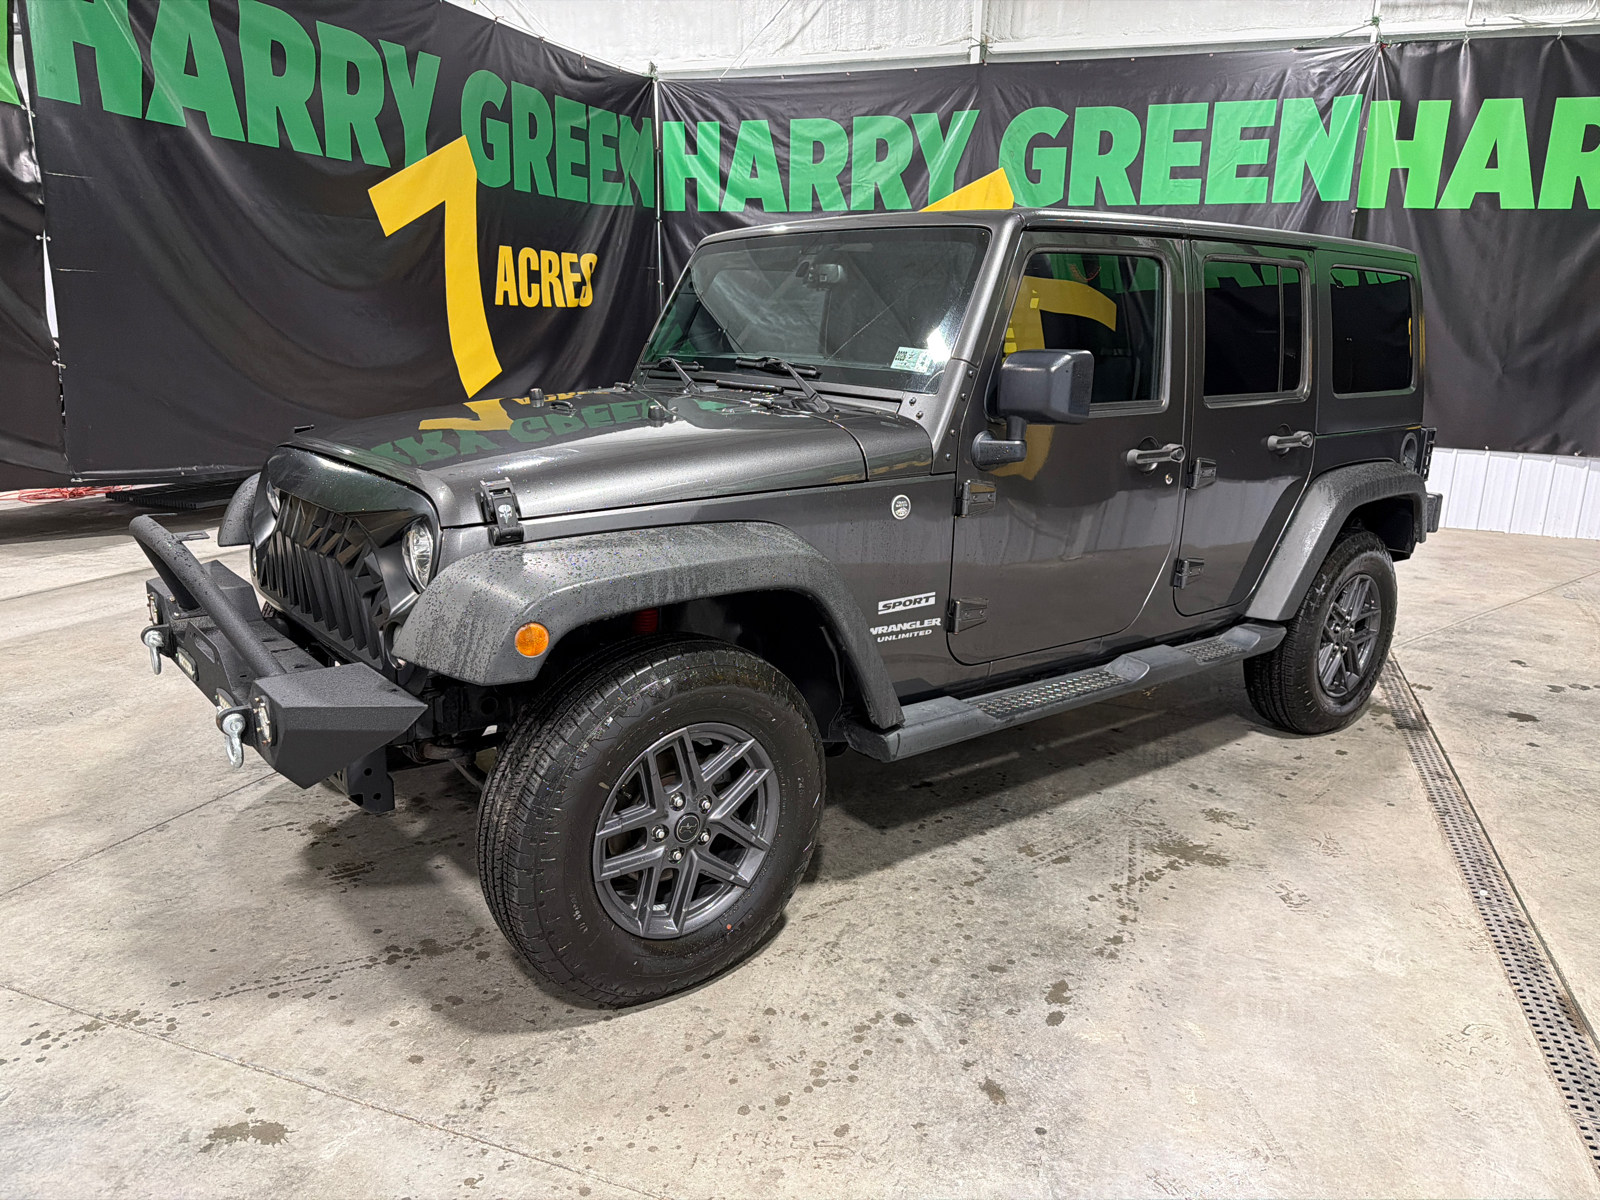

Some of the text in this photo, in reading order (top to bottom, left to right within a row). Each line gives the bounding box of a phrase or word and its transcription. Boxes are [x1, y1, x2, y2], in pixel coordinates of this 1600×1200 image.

[26, 0, 441, 168] HARRY
[460, 69, 655, 208] GREEN
[662, 110, 980, 213] HARRY
[998, 94, 1364, 208] GREEN
[367, 135, 598, 398] 7 ACRES
[869, 617, 942, 636] WRANGLER
[876, 629, 933, 643] UNLIMITED
[881, 596, 931, 611] SPORT
